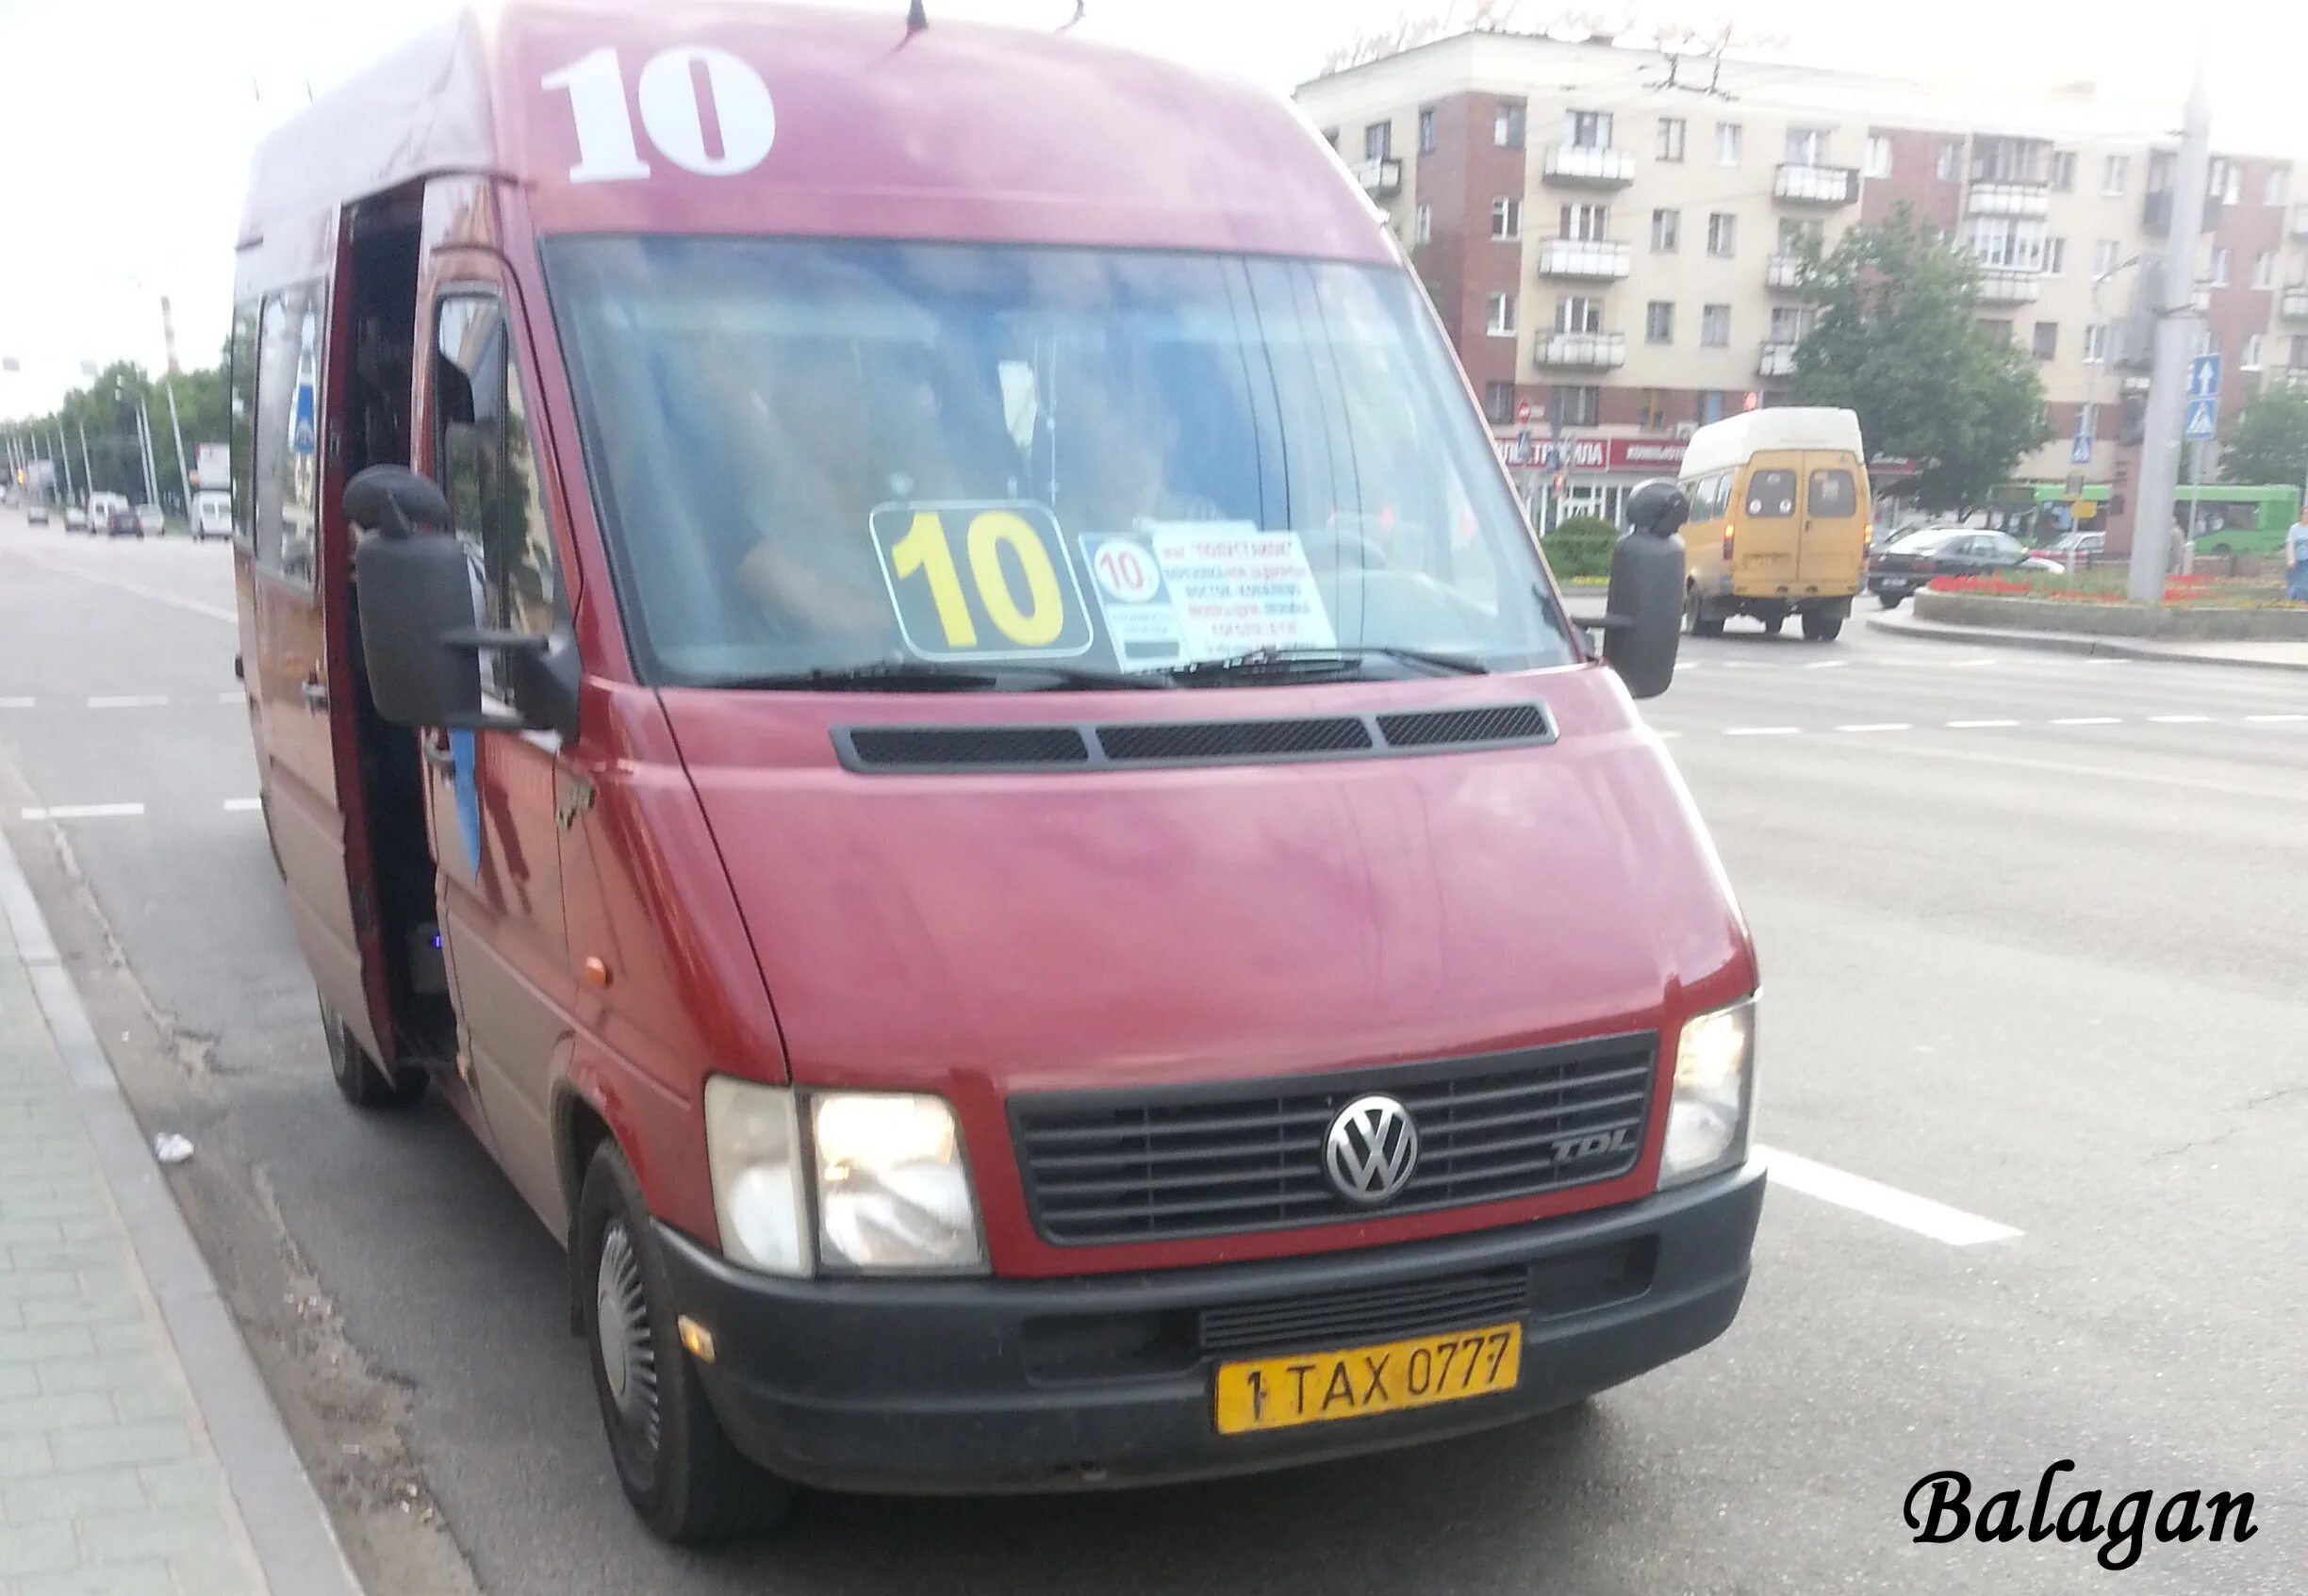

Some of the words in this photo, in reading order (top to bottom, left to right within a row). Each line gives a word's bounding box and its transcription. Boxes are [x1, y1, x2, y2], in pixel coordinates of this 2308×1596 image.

[540, 46, 776, 184] 10
[891, 510, 1064, 648] 10
[1098, 550, 1146, 591] 10
[1408, 1331, 1511, 1396] 0777
